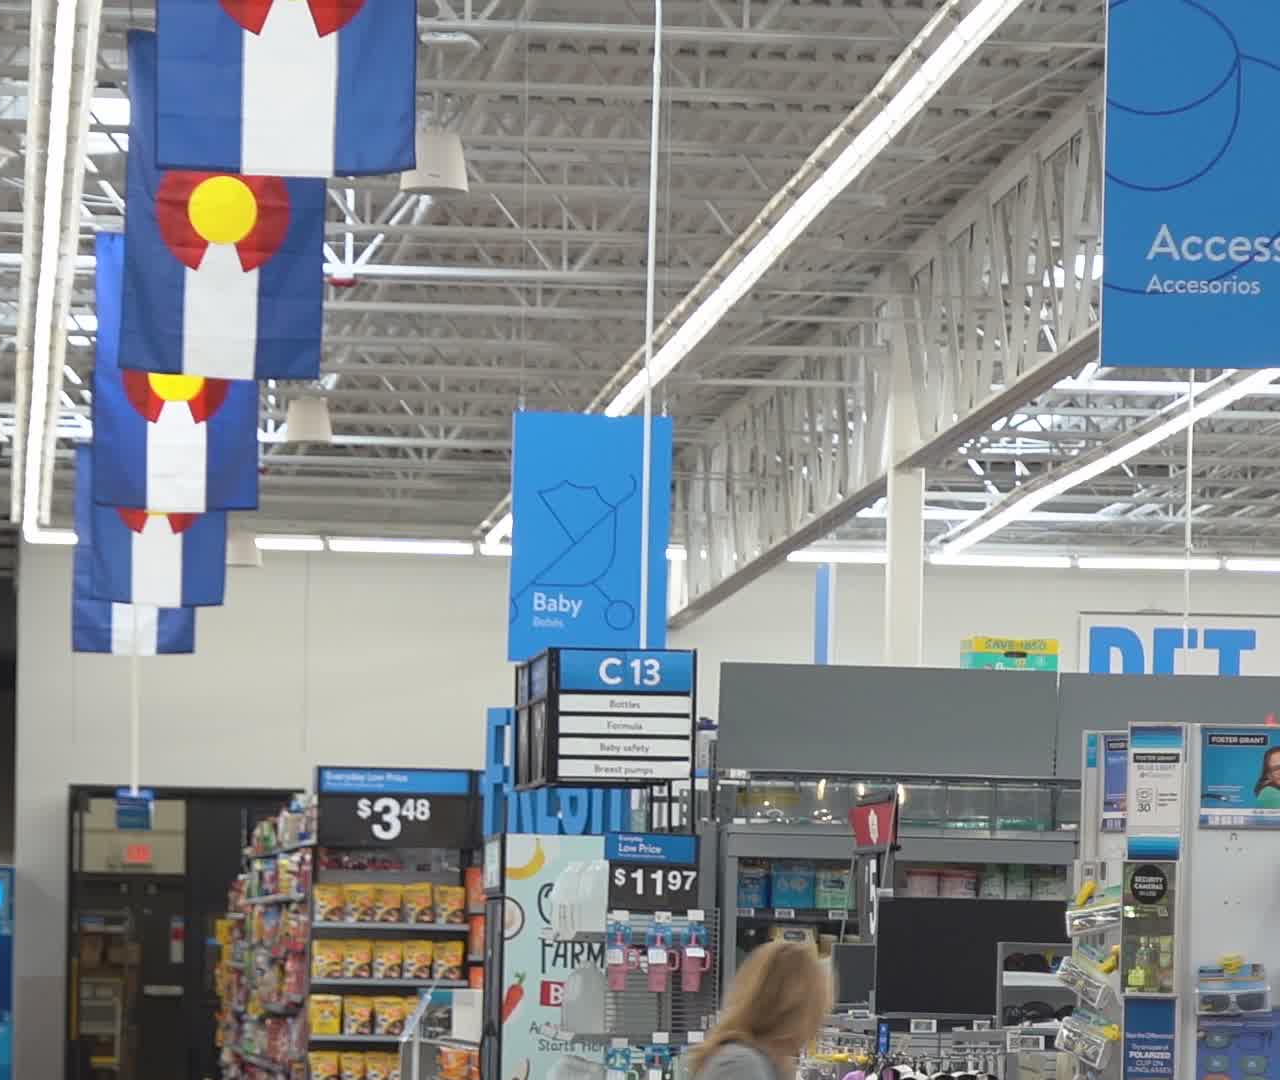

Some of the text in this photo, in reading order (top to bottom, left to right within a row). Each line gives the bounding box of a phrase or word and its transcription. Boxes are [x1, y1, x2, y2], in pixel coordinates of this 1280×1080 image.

[1146, 274, 1261, 295] Accesorios
[532, 591, 583, 618] Baby
[598, 657, 662, 686] C 13
[609, 699, 641, 710] Bottles
[606, 720, 643, 731] Formula
[599, 742, 650, 754] Baby safety
[593, 764, 654, 776] Breast pumps
[356, 797, 431, 840] $348
[613, 867, 697, 896] $1197
[538, 937, 605, 974] FARM
